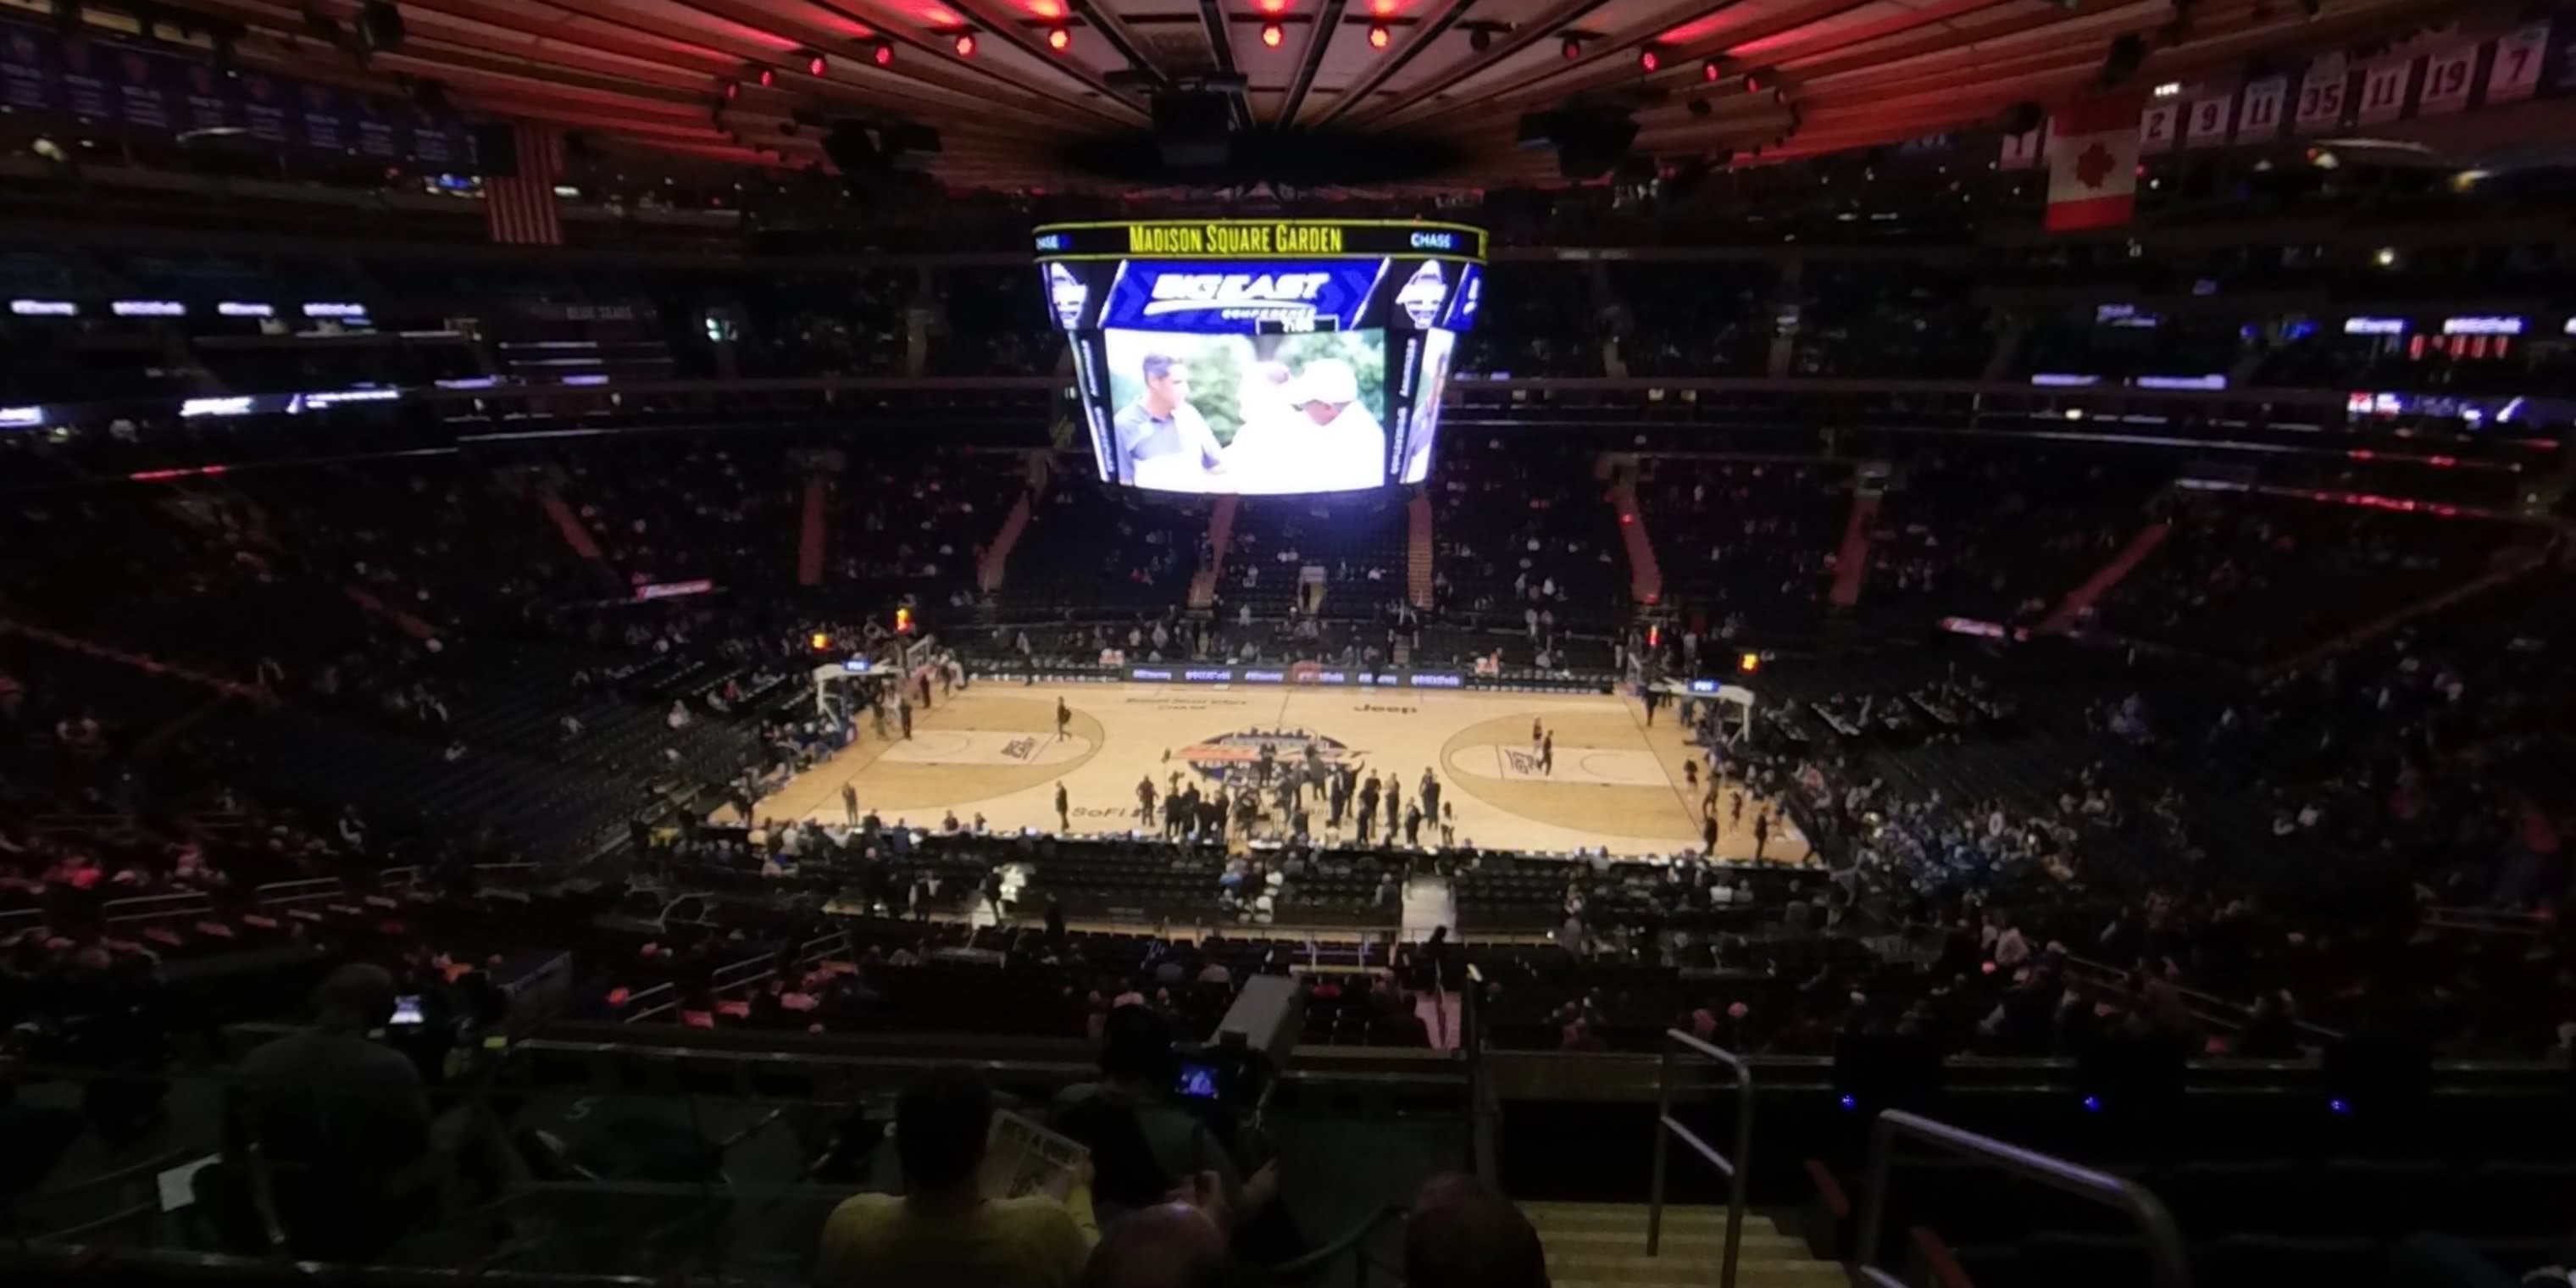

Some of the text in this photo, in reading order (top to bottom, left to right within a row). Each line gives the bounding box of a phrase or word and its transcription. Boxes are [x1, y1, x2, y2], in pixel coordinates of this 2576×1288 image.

[2429, 61, 2467, 95] 19
[2511, 48, 2529, 81] 7
[2301, 84, 2340, 116] 35
[2369, 75, 2396, 107] 11
[2148, 113, 2166, 137] 2
[2201, 104, 2218, 130] 9
[1130, 225, 1343, 253] MADISON SQUARE GARDEN
[1410, 232, 1451, 248] CHASE
[1151, 273, 1330, 300] BIG EAST
